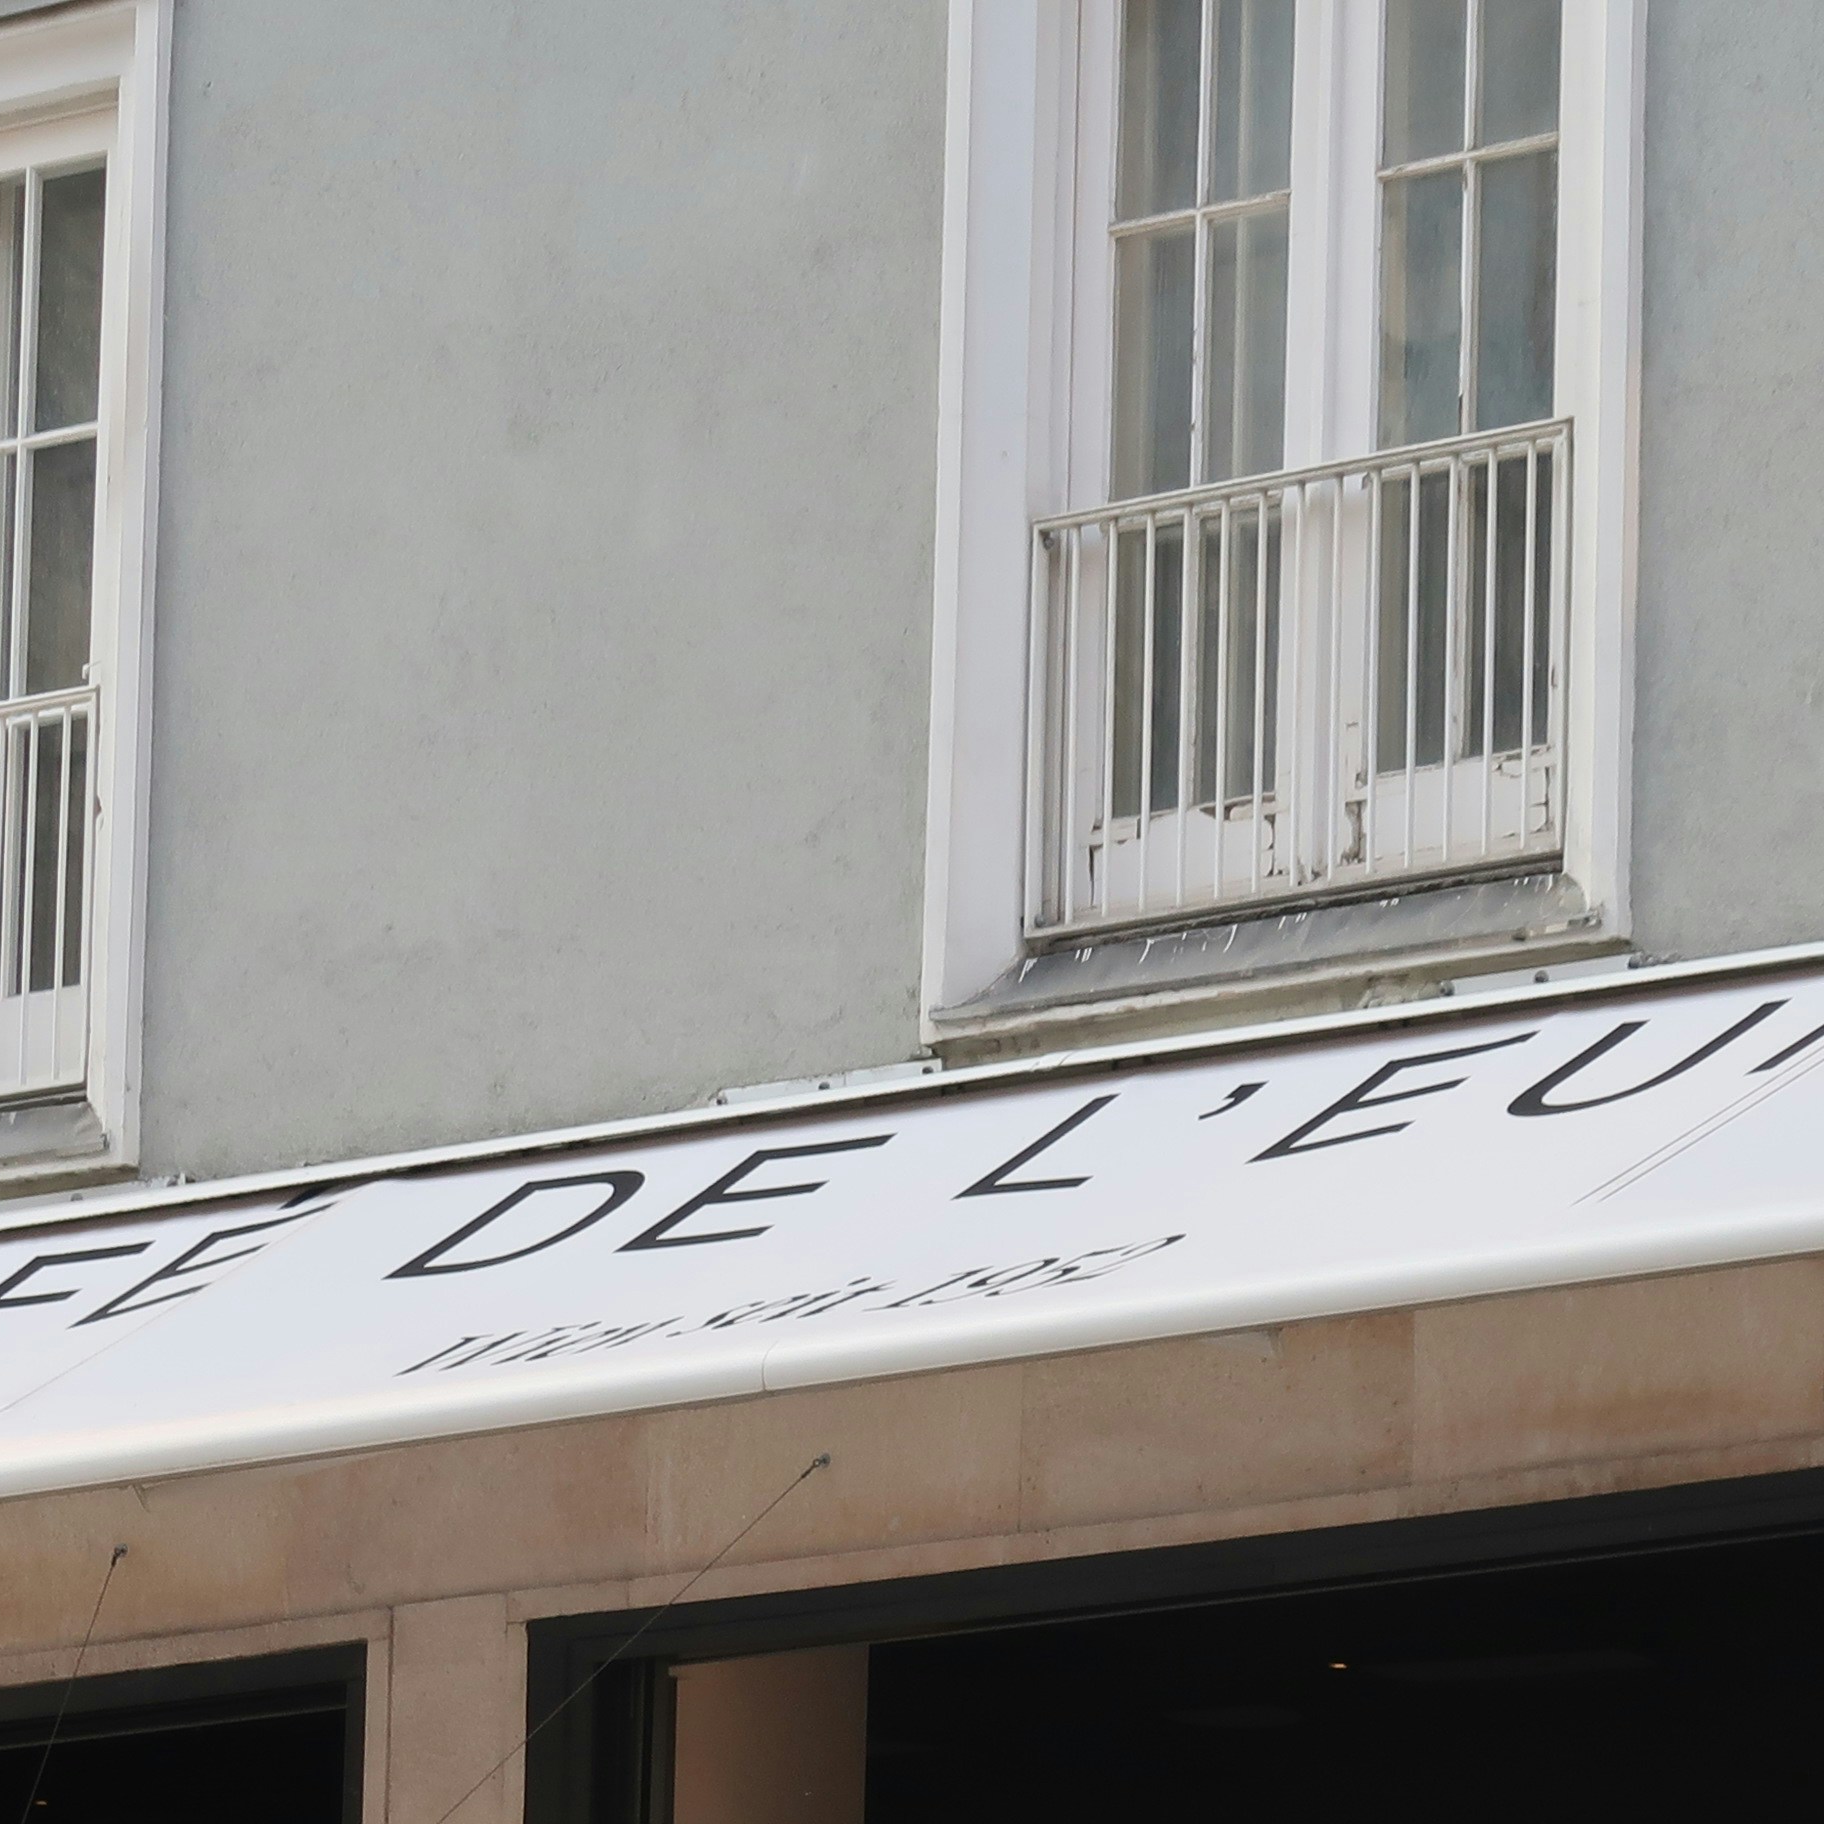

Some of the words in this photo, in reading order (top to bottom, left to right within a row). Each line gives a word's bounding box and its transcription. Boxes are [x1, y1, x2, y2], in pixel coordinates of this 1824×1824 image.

[382, 1132, 898, 1280] DE
[393, 1321, 685, 1377] Wien
[666, 1278, 894, 1338] seit
[864, 1234, 1187, 1312] 1952
